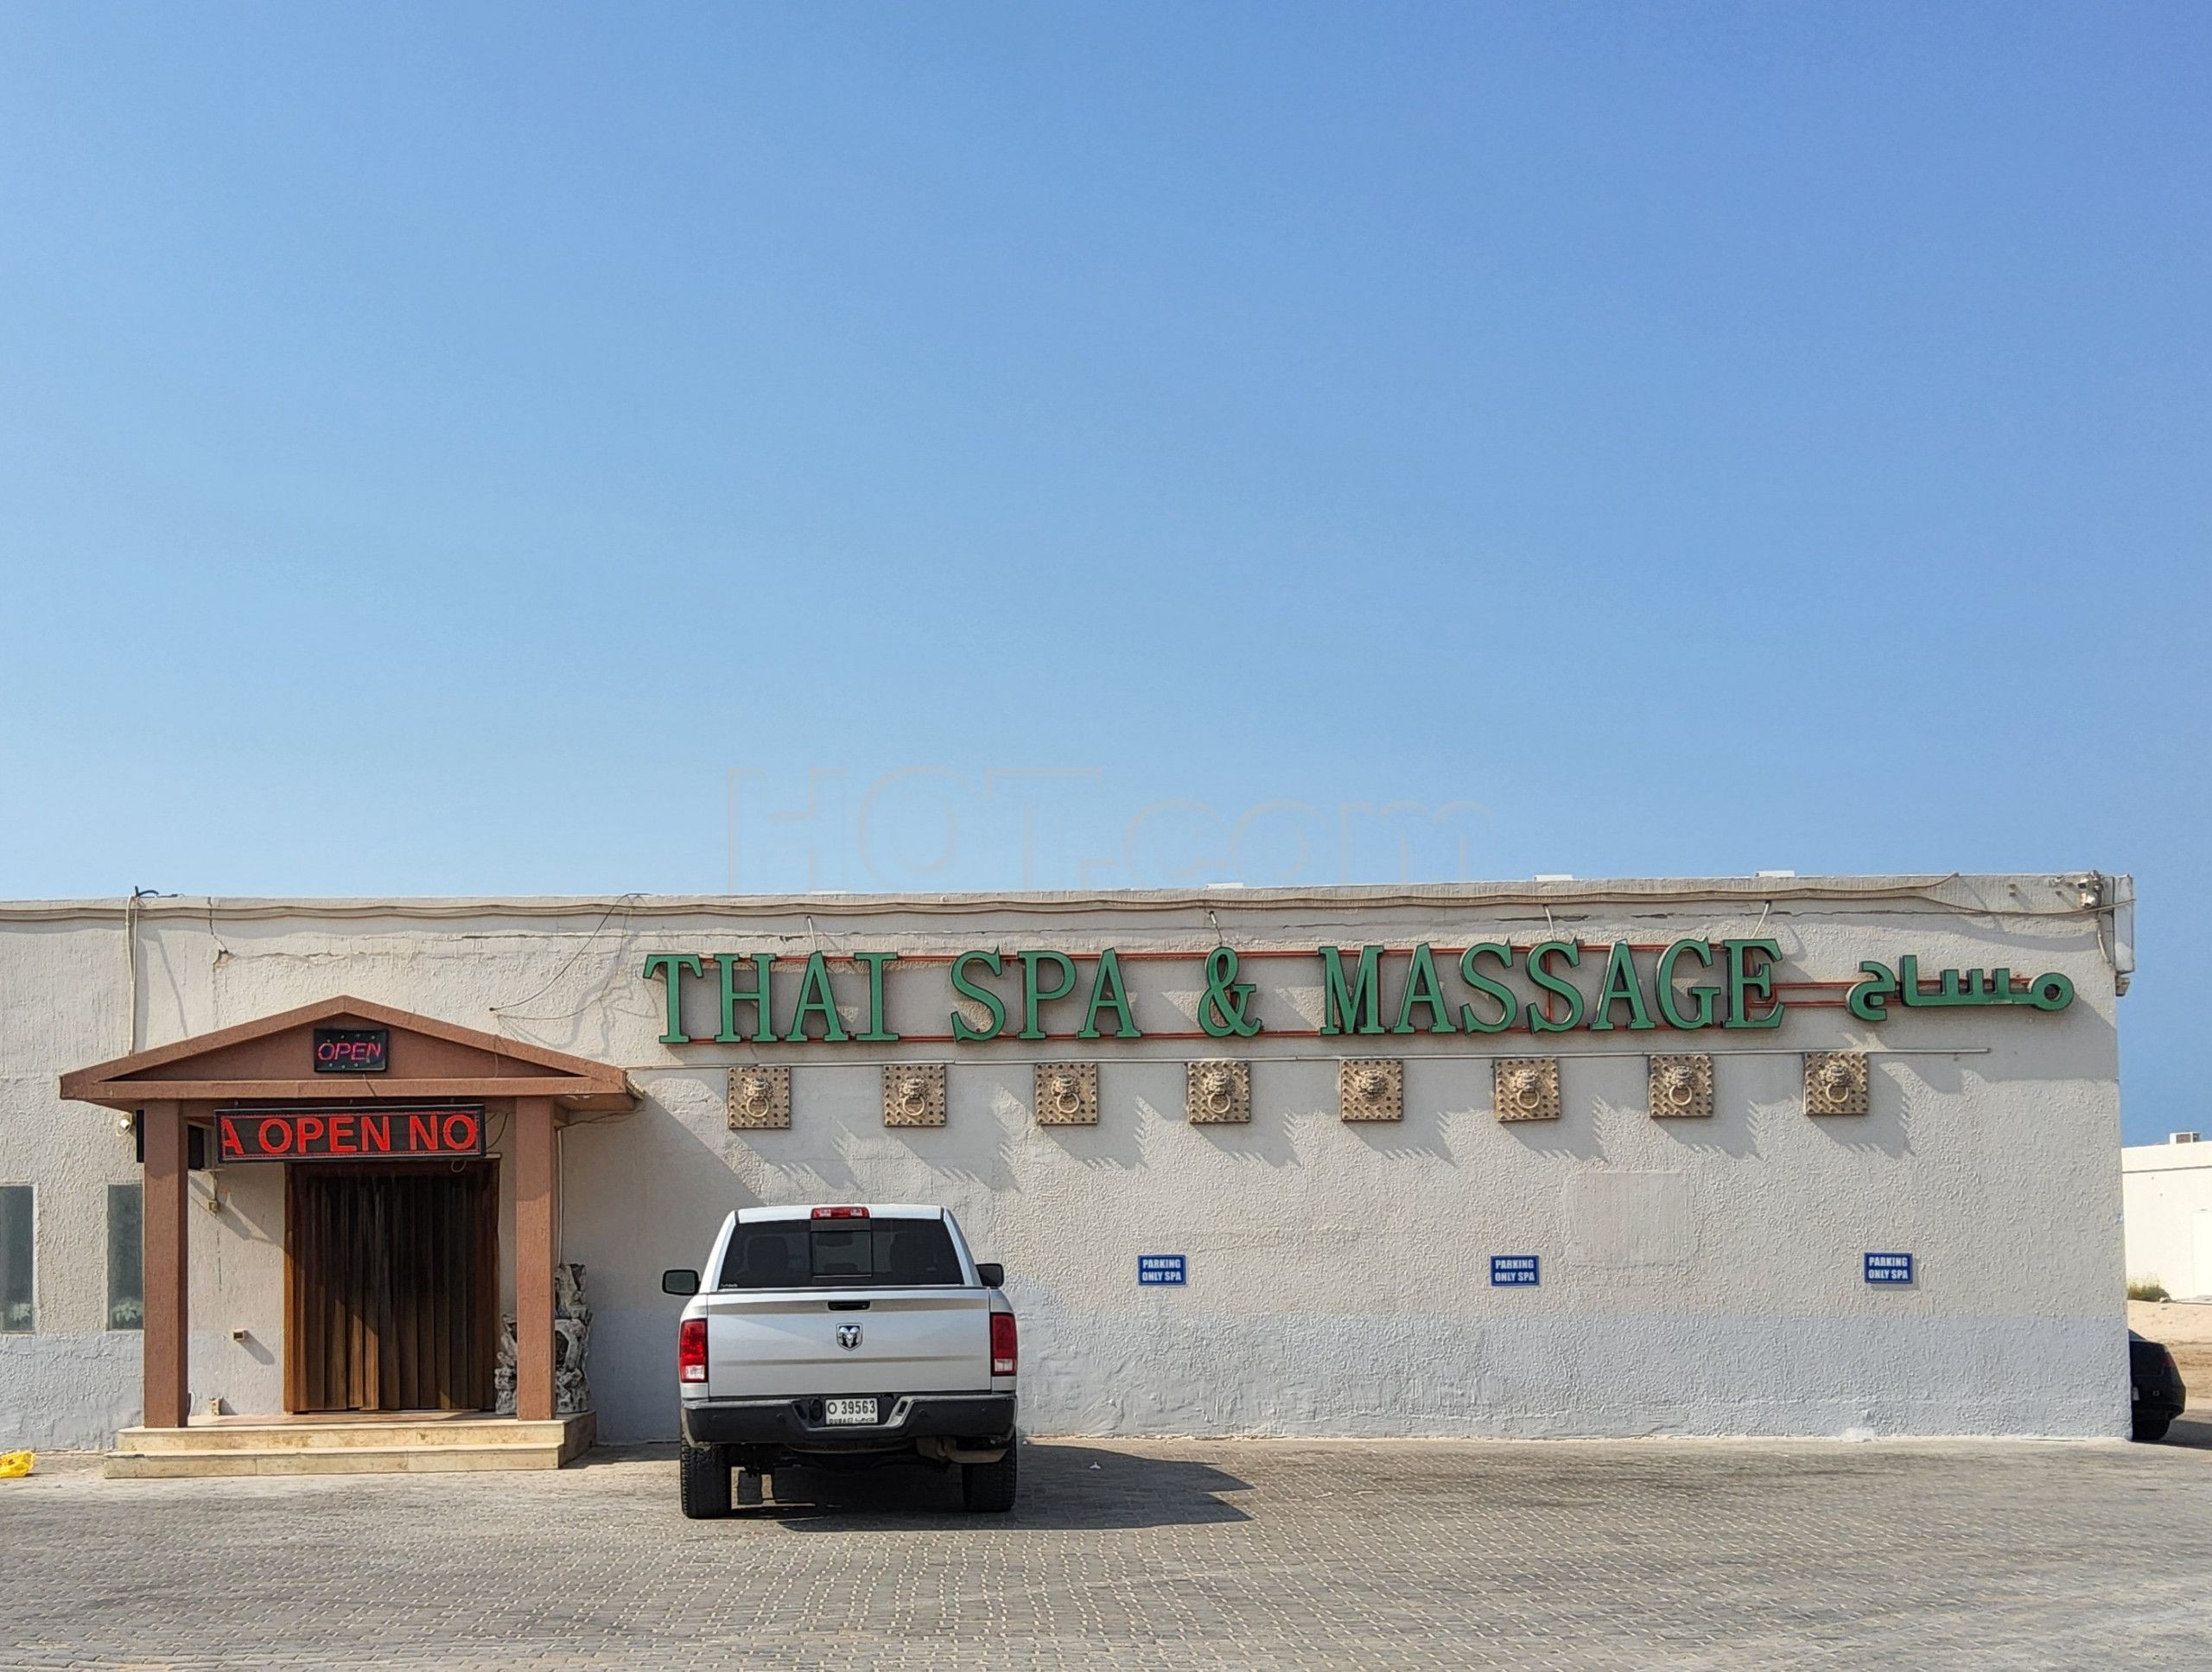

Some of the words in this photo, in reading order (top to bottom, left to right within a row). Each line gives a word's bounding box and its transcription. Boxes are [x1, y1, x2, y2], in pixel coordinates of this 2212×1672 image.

[642, 950, 899, 1045] THAI
[950, 945, 1141, 1042] SPA
[1198, 945, 1262, 1037] &
[1318, 937, 1783, 1036] MASSAGE
[1847, 954, 2075, 1022] مساج
[317, 1040, 382, 1062] OPEN
[258, 1116, 391, 1154] OPEN
[409, 1114, 478, 1152] NO
[1142, 1259, 1181, 1269] PARKING
[1495, 1259, 1535, 1269] PARKING
[1869, 1256, 1908, 1267] PARKING
[1141, 1271, 1163, 1281] ONLY
[1164, 1271, 1182, 1281] SPA
[1494, 1272, 1516, 1281] ONLY
[1517, 1272, 1535, 1281] SPA
[1868, 1269, 1890, 1279] ONLY
[1891, 1269, 1909, 1280] SPA
[827, 1402, 837, 1415] O
[841, 1400, 876, 1415] 39563
